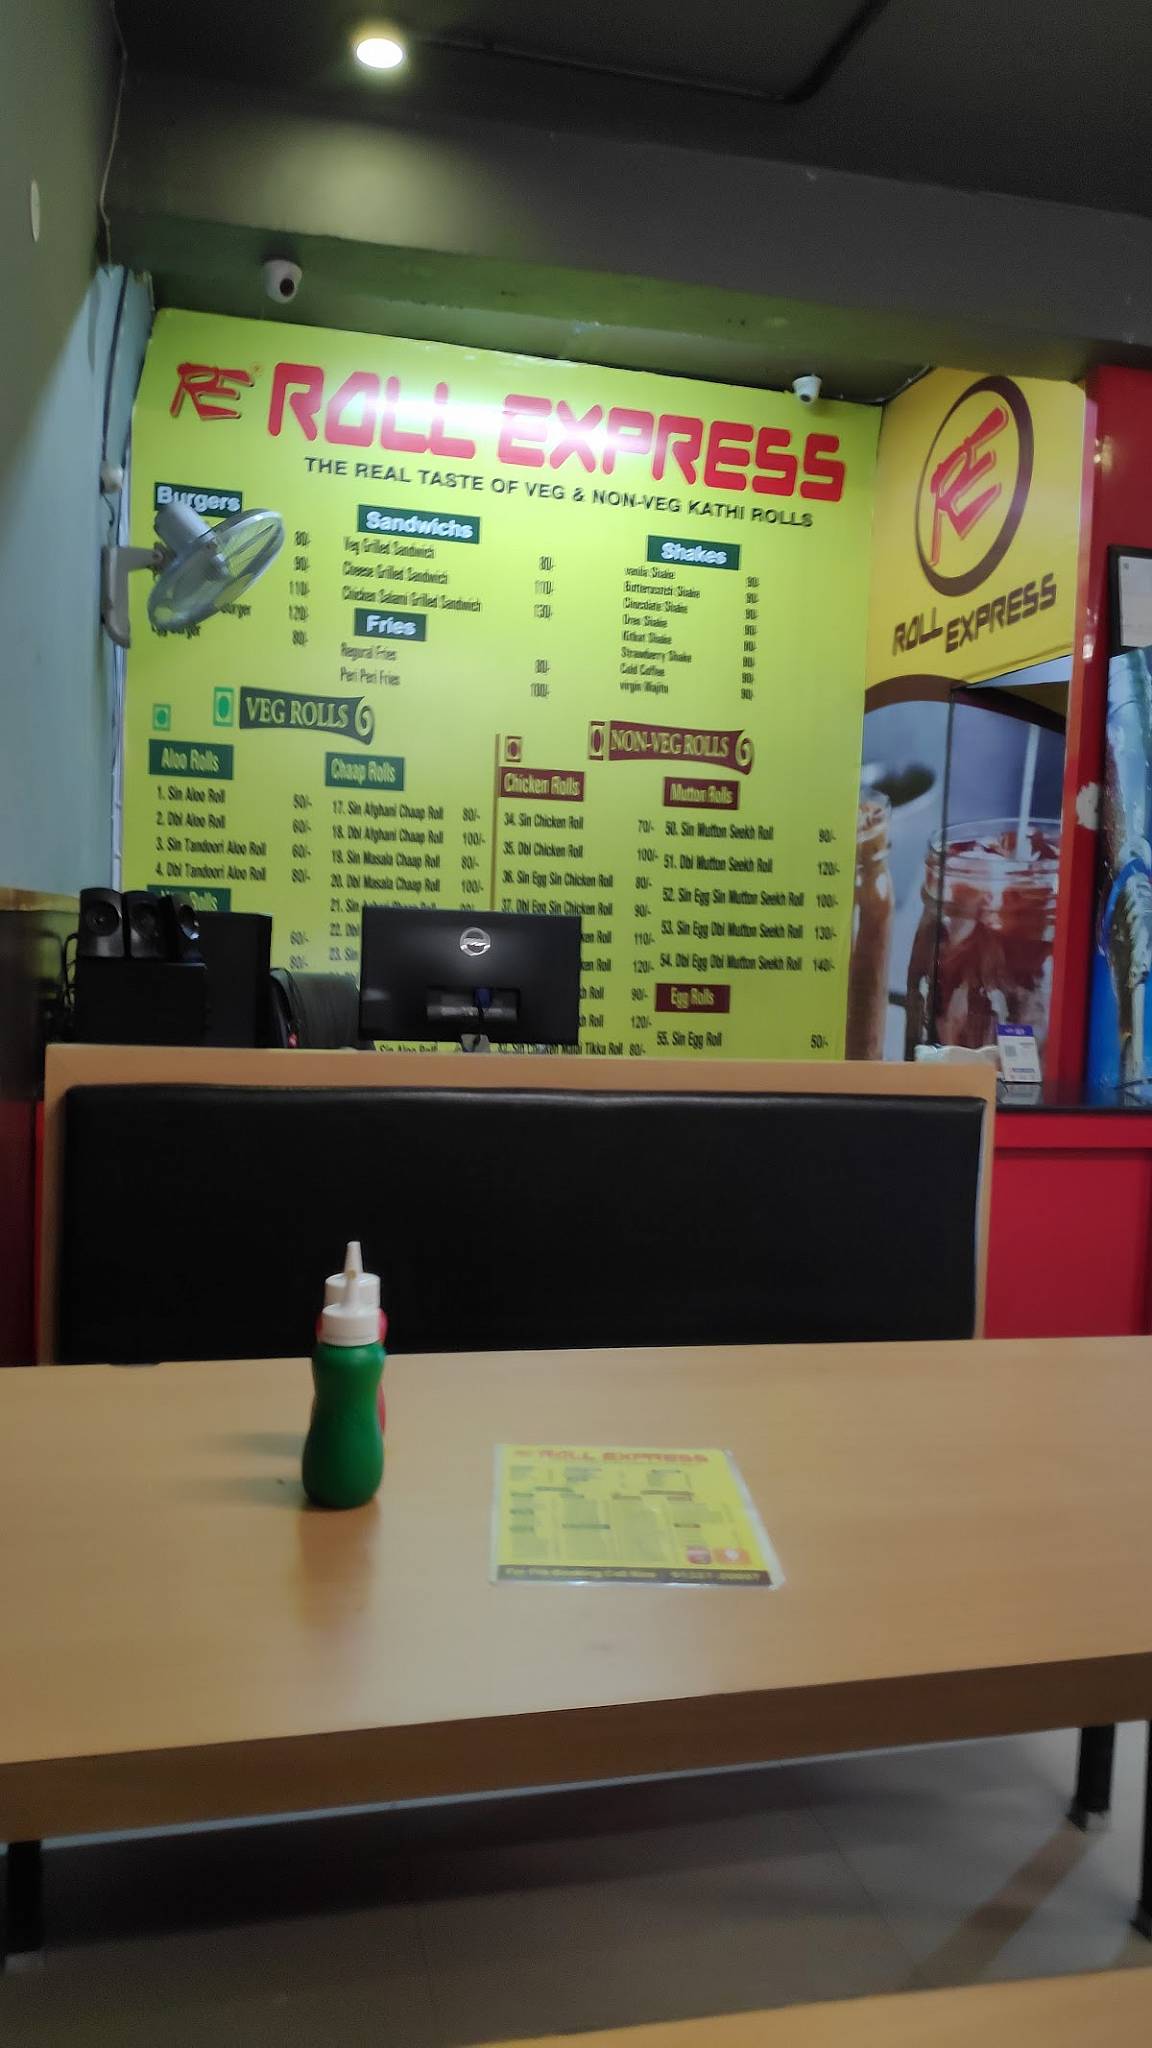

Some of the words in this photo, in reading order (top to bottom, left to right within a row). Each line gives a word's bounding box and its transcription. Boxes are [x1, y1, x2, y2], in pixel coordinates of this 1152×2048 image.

[170, 362, 254, 420] RE
[268, 362, 476, 460] ROLL
[498, 393, 845, 502] EXPRESS
[305, 457, 348, 476] THE
[356, 462, 410, 484] REAL
[418, 470, 484, 491] TASTE
[491, 479, 518, 494] OF
[526, 482, 564, 500] VEG
[574, 488, 584, 501] &
[592, 490, 680, 512] NON-VEG
[687, 500, 744, 520] KATHI
[752, 507, 812, 527] ROLLS
[928, 406, 1009, 567] RE
[157, 486, 240, 512] Burgers
[366, 511, 472, 538] Sandwichs
[345, 537, 360, 555] Veg
[362, 538, 390, 554] Grilled
[393, 541, 434, 558] Sandwich
[661, 542, 727, 565] Shakes
[344, 561, 373, 577] Cheese
[376, 564, 403, 580] Grilled
[407, 567, 448, 584] Sandwich
[343, 586, 376, 602] Chicken
[378, 589, 408, 604] Salami
[412, 592, 438, 608] Grilled
[440, 595, 480, 612] Sandwich
[892, 607, 942, 656] ROLL
[946, 573, 1056, 653] EXPRESS
[366, 615, 416, 636] Fries
[340, 666, 357, 682] Peri
[360, 668, 376, 684] Peri
[380, 670, 400, 686] Fries
[620, 663, 638, 674] Cold
[640, 664, 664, 676] Coffee
[246, 697, 284, 723] VEG
[290, 700, 348, 728] ROLLS
[611, 730, 682, 754] NON-VEG
[684, 734, 729, 758] ROLLS
[161, 748, 186, 770] Aloo
[190, 749, 219, 772] Rolls
[331, 758, 364, 785] Chaap
[368, 761, 396, 784] Rolls
[504, 772, 549, 794] Chicken
[551, 776, 580, 796] Rolls
[670, 783, 706, 802] Mutton
[708, 785, 733, 804] Rolls
[157, 786, 164, 800] 1.
[168, 786, 182, 800] Sin
[186, 788, 205, 802] Aloo
[208, 788, 225, 803] Roll
[156, 812, 164, 826] 2.
[168, 812, 182, 826] Dbl
[186, 813, 205, 828] Aloo
[208, 814, 226, 828] Roll
[332, 800, 345, 814] 17.
[348, 801, 361, 816] Sin
[364, 803, 396, 820] Afghani
[400, 804, 425, 821] Chaap
[428, 806, 443, 820] Roll
[504, 812, 516, 826] 34.
[519, 813, 531, 827] Sin
[534, 814, 566, 828] Chicken
[569, 816, 583, 830] Roll
[638, 820, 654, 832] 70/-
[666, 821, 678, 836] 50.
[682, 822, 694, 836] Sin
[698, 822, 726, 838] Mutton
[730, 824, 754, 839] Seekh
[758, 826, 774, 840] Roll
[332, 825, 344, 839] 18.
[348, 826, 361, 840] Dbl
[364, 827, 396, 844] Afghani
[400, 828, 425, 846] Chaap
[428, 830, 443, 844] Roll
[463, 832, 485, 846] 100/-
[156, 837, 164, 851] 3.
[168, 837, 182, 852] Sin
[186, 838, 224, 854] Tandoori
[228, 840, 247, 855] Aloo
[250, 842, 266, 856] Roll
[504, 841, 514, 855] 35.
[518, 842, 531, 856] Dbl
[534, 842, 566, 857] Chicken
[568, 844, 583, 858] Roll
[637, 848, 658, 862] 100/-
[346, 850, 360, 864] Sin
[364, 852, 393, 866] Masala
[396, 853, 422, 870] Chaap
[425, 854, 440, 868] Roll
[664, 854, 676, 868] 51.
[680, 855, 693, 870] Dbl
[697, 855, 726, 870] Mutton
[728, 857, 754, 872] Seekh
[757, 858, 772, 872] Roll
[156, 862, 164, 876] 4.
[167, 862, 181, 877] Dbl
[185, 864, 224, 879] Tandoori
[227, 866, 247, 880] Aloo
[250, 866, 266, 881] Roll
[502, 870, 514, 884] 36.
[517, 870, 529, 884] Sin
[532, 872, 546, 888] Egg
[550, 872, 562, 886] Sin
[564, 873, 595, 887] Chicken
[599, 874, 613, 888] Roll
[462, 880, 484, 894] 100/-
[663, 887, 674, 902] 52.
[678, 888, 691, 902] Sin
[695, 888, 710, 906] Egg
[713, 890, 726, 904] Sin
[729, 890, 758, 904] Mutton
[760, 891, 786, 906] Seekh
[789, 892, 804, 906] Roll
[634, 904, 651, 917] 90/-
[597, 930, 611, 944] Roll
[635, 932, 654, 945] 110/-
[662, 920, 674, 934] 53.
[677, 920, 690, 935] Sin
[693, 922, 708, 939] Egg
[712, 922, 724, 936] Dbl
[728, 922, 756, 938] Mutton
[760, 924, 784, 938] Seekh
[788, 924, 803, 939] Roll
[596, 959, 611, 972] Roll
[633, 960, 654, 973] 120/-
[660, 954, 672, 968] 54.
[676, 954, 689, 968] Dbl
[692, 954, 708, 971] Egg
[710, 954, 724, 969] Dbl
[728, 954, 756, 970] Mutton
[759, 956, 784, 970] Seekh
[786, 956, 802, 970] Roll
[590, 987, 604, 1000] Roll
[632, 988, 648, 1000] 90/-
[671, 987, 688, 1008] Egg
[690, 988, 714, 1006] Rolls
[589, 1015, 603, 1028] Roll
[631, 1015, 652, 1028] 120/-
[586, 1042, 606, 1055] Tikka
[608, 1043, 622, 1056] Roll
[657, 1032, 669, 1046] 55.
[672, 1032, 685, 1046] Sin
[688, 1032, 703, 1049] Egg
[706, 1032, 722, 1046] Roll
[811, 1034, 828, 1048] 50/-
[540, 1450, 595, 1461] ROLL
[602, 1452, 708, 1463] EXPRESS
